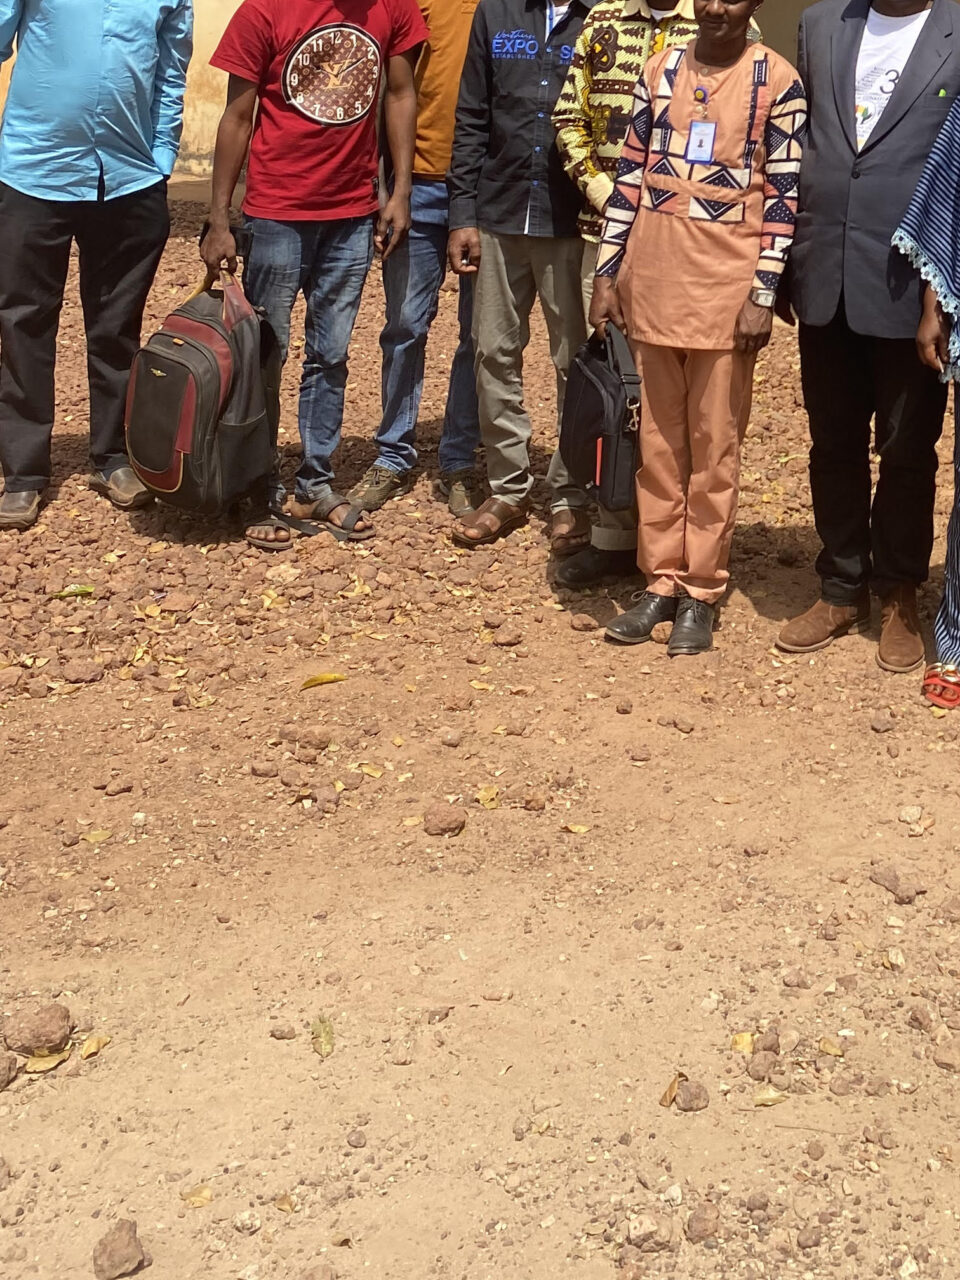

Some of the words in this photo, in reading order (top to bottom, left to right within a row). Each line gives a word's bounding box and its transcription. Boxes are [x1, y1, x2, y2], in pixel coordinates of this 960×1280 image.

[329, 31, 342, 44] 12
[350, 34, 357, 47] 1
[311, 39, 323, 52] 11
[492, 39, 538, 54] EXPO
[367, 46, 375, 59] 2
[297, 53, 310, 66] 10
[372, 65, 378, 79] 3
[290, 73, 299, 86] 9
[296, 91, 304, 103] 8
[366, 85, 373, 98] 4
[313, 104, 320, 116] 7
[336, 107, 344, 120] 6
[354, 101, 362, 113] 5
